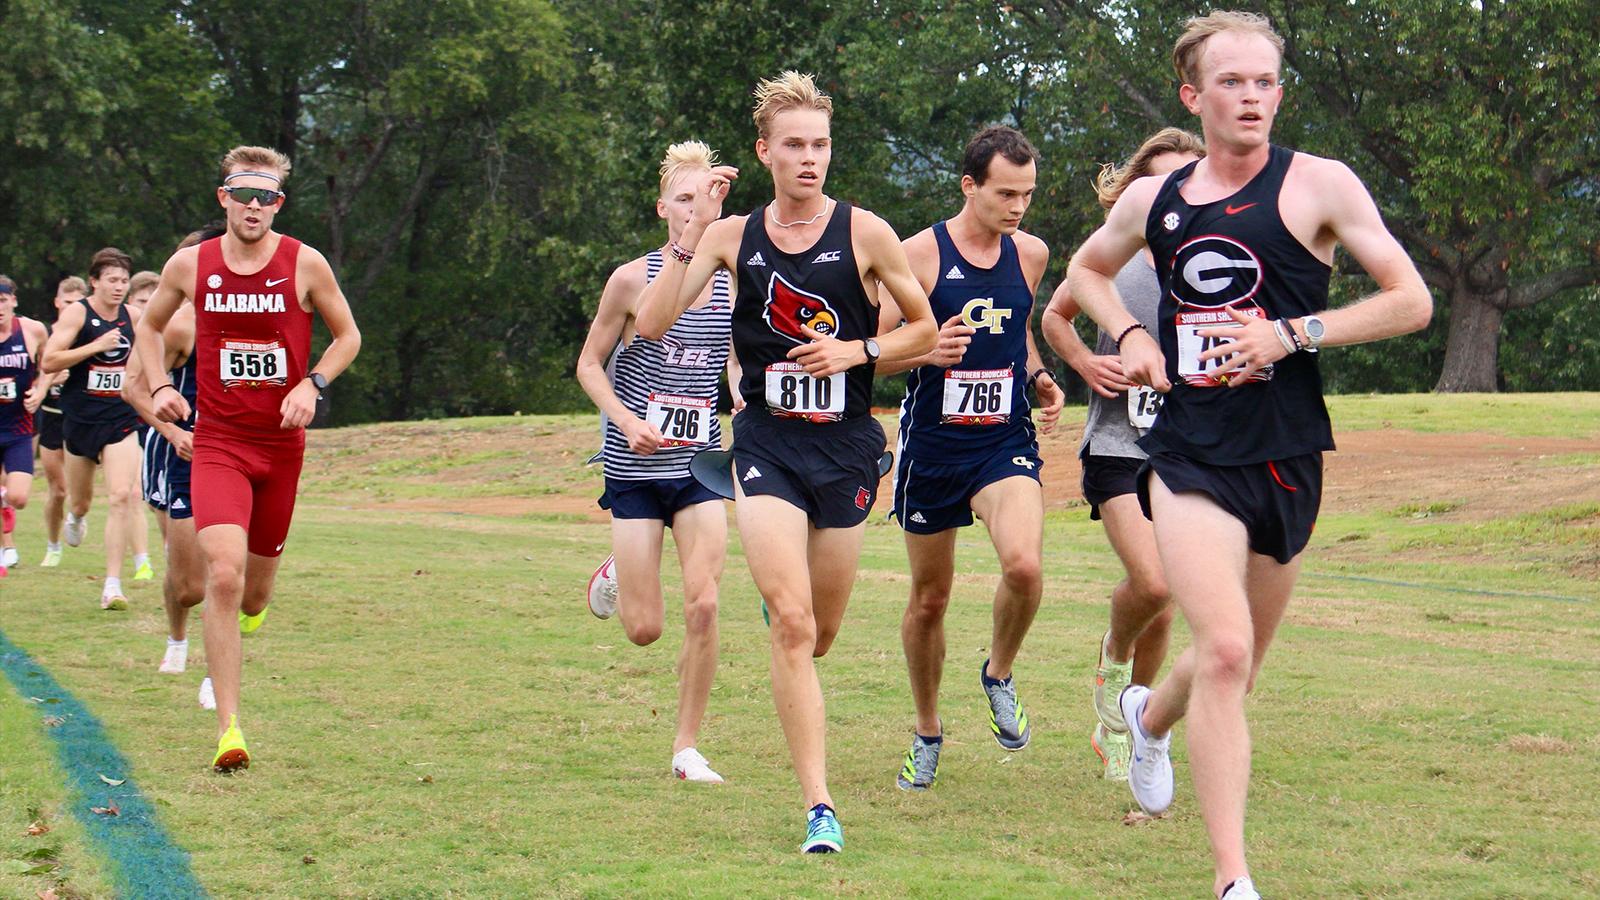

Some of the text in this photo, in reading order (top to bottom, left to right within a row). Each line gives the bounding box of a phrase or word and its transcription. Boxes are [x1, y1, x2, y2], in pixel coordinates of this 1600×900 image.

[812, 251, 841, 263] ACC
[1181, 249, 1258, 295] G
[204, 293, 286, 312] ALABAMA
[961, 298, 1012, 333] GT
[1181, 311, 1217, 323] SOUTHERN
[230, 353, 277, 377] 558
[664, 346, 712, 368] LEE
[771, 362, 803, 371] SOUTHER
[96, 373, 120, 389] 750
[951, 369, 1009, 379] SOUTHERN SHOWCASE
[654, 394, 707, 408] SOUTHERN SHOWCASE
[781, 375, 831, 410] 810
[958, 382, 1002, 413] 766
[660, 406, 700, 439] 796
